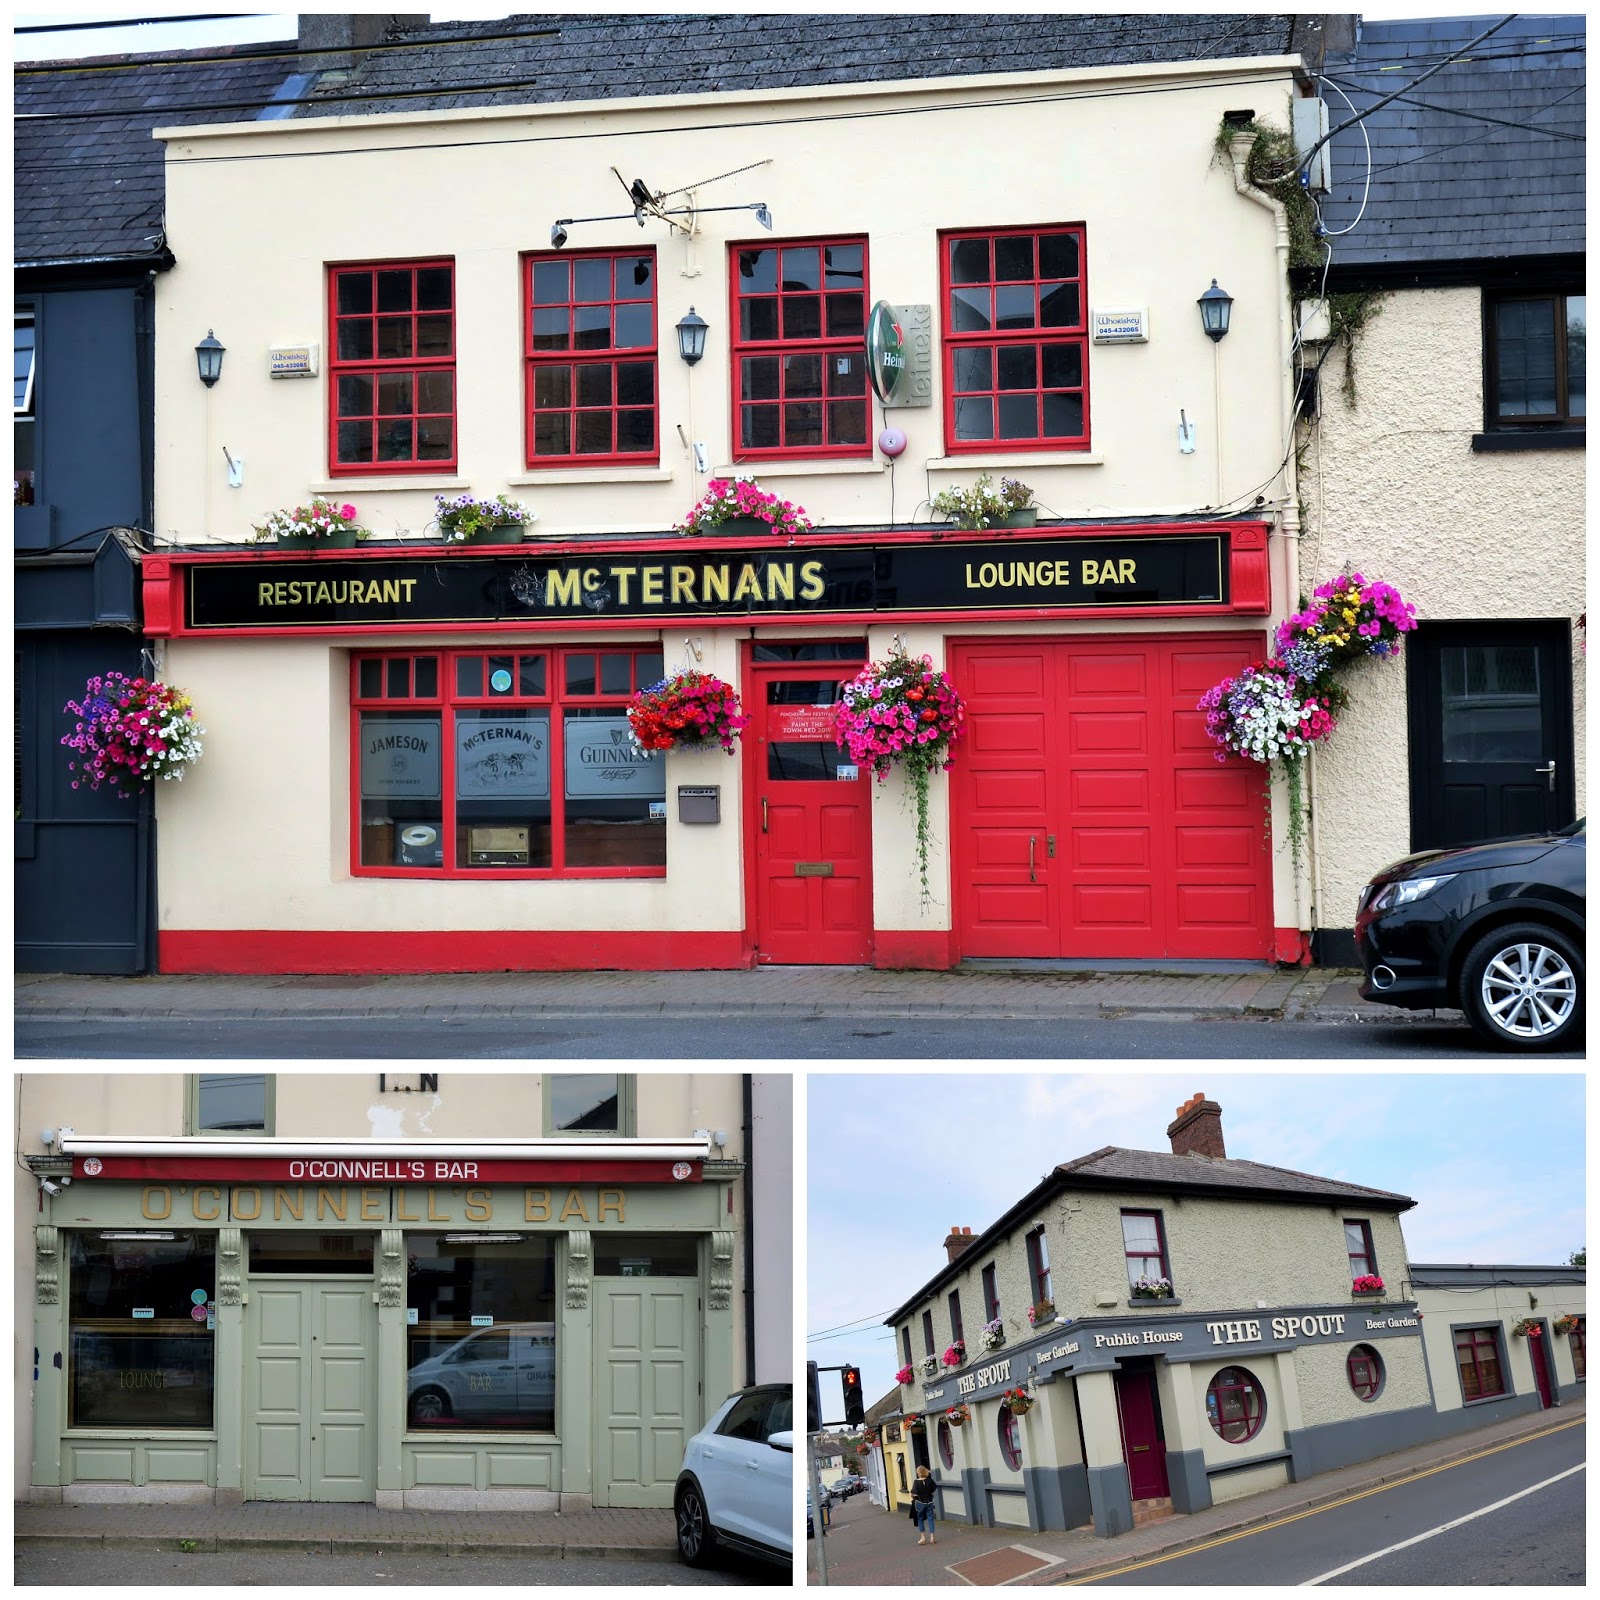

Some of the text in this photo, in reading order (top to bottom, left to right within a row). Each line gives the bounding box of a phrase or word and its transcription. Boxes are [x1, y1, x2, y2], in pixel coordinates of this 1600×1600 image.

[965, 558, 1136, 589] LOUNGE BAR
[258, 579, 417, 606] RESTAURANT
[370, 735, 428, 754] JAMESON
[289, 1160, 478, 1180] O'CONNELL'S BAR
[141, 1185, 626, 1223] O'CONNELL'S BAR
[1207, 1314, 1346, 1345] THE SPOUT
[1366, 1317, 1418, 1330] Beer Garden
[1094, 1331, 1184, 1348] Public House
[1036, 1341, 1080, 1364] Beer Garden
[120, 1371, 168, 1389] LOUNGE
[470, 1375, 493, 1392] BAR
[957, 1359, 1011, 1395] THE SPOUT
